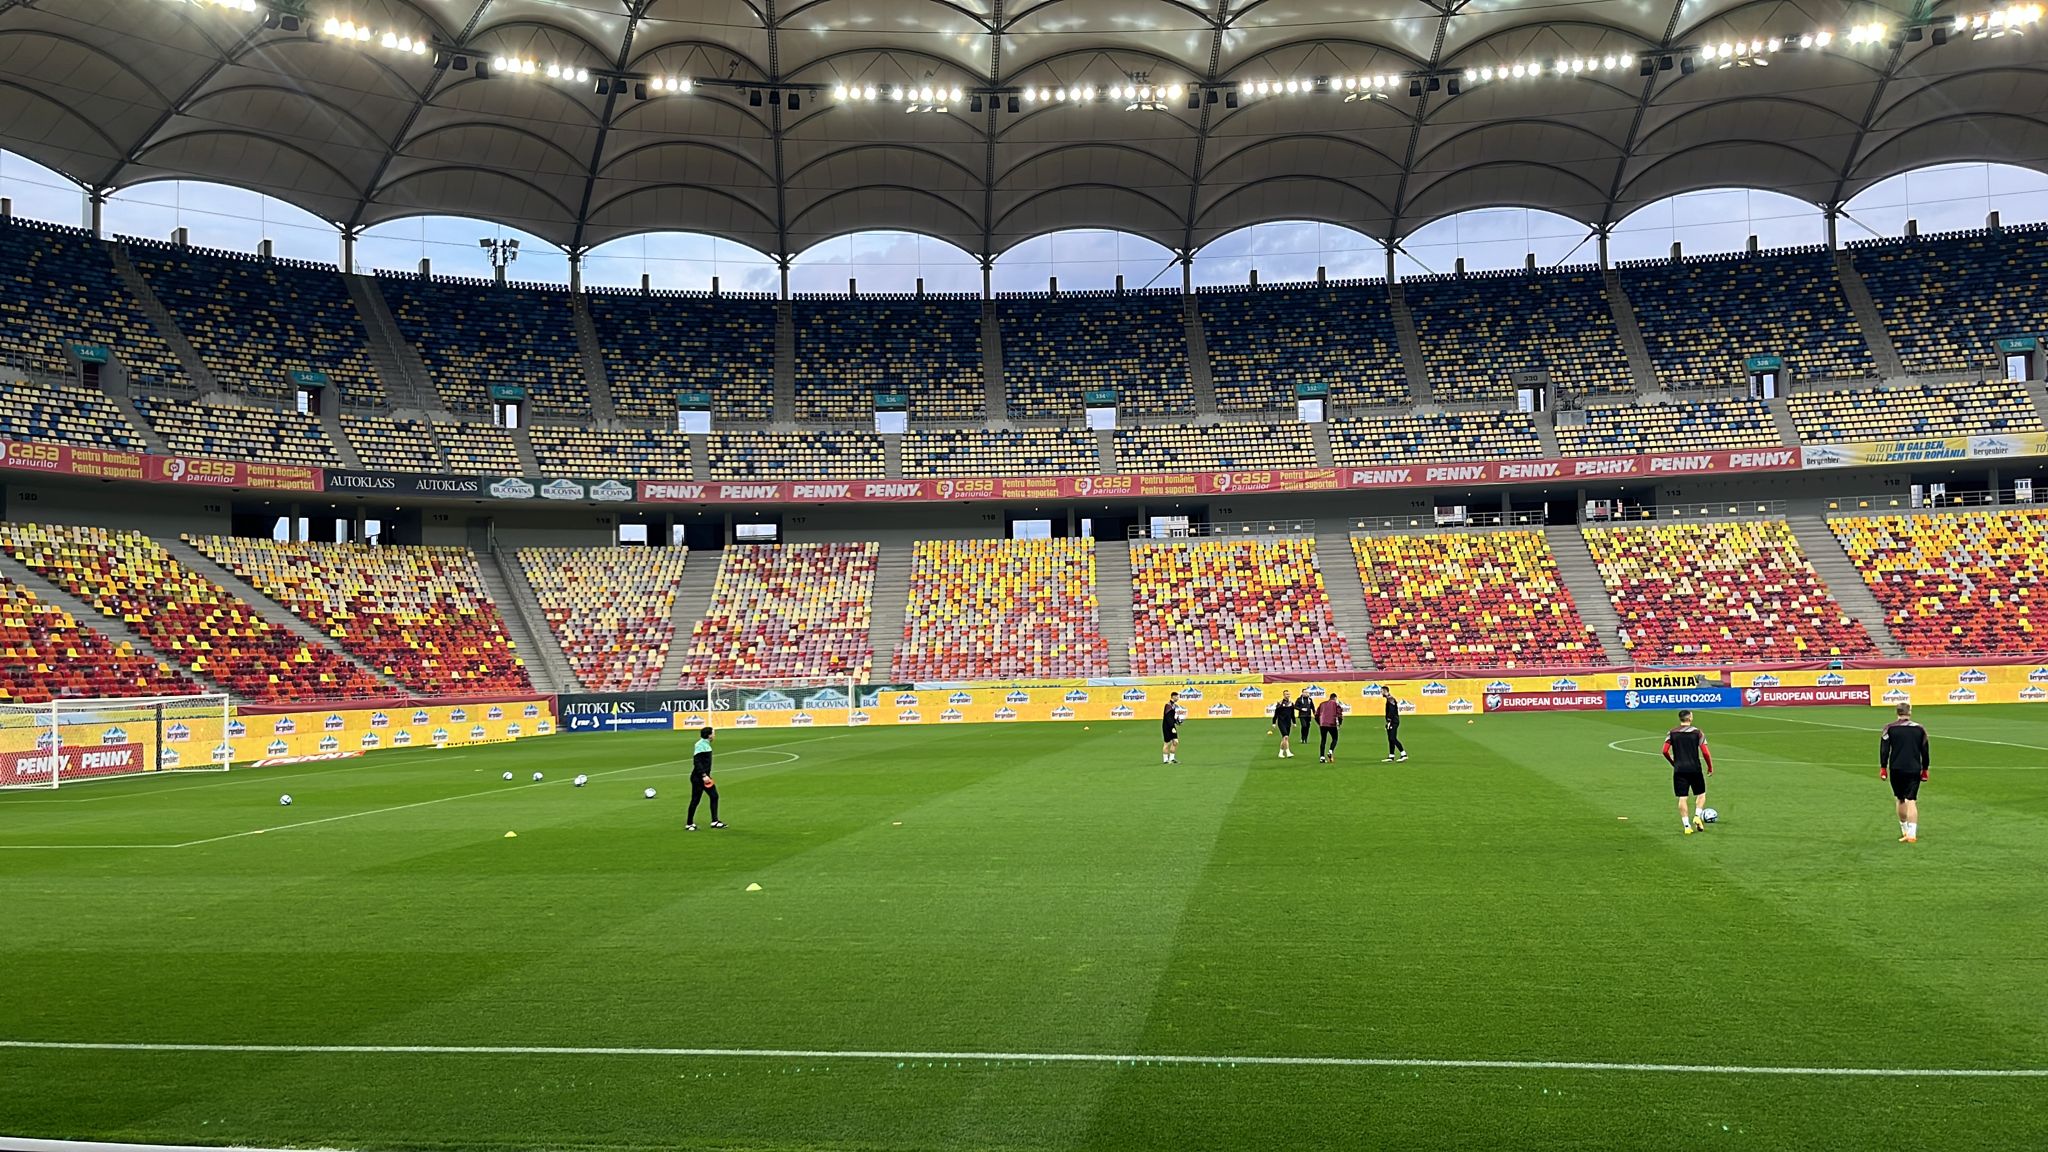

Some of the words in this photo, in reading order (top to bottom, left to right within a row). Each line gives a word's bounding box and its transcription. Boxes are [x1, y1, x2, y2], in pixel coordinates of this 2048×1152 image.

[80, 348, 94, 357] 344
[9, 442, 60, 461] casa
[71, 448, 101, 461] Pentru
[1886, 451, 1922, 462] PENTRU
[1924, 447, 1966, 460] ROMÂNIA
[8, 458, 59, 470] pariurilor
[72, 462, 101, 475] Pentru
[188, 460, 236, 476] casa
[247, 463, 276, 475] Pentru
[187, 473, 235, 484] pariurilor
[247, 476, 275, 488] Pentru
[330, 475, 396, 489] AUTOKLASS
[1093, 476, 1132, 488] casa
[1232, 472, 1272, 485] casa
[416, 479, 478, 492] AUTOKLASS
[493, 487, 532, 495] BUCOVINA
[956, 480, 993, 491] casa
[543, 488, 582, 496] BUCOVINA
[592, 489, 630, 497] BUCOVINA
[1634, 675, 1697, 688] ROMÂNIA
[1503, 697, 1550, 707] EUROPEAN
[1552, 696, 1604, 706] QUALIFIERS
[1763, 692, 1814, 702] EUROPEAN
[1816, 690, 1869, 701] QUALIFIERS
[747, 701, 793, 710] BUCOVINA
[805, 700, 850, 709] BUCOVINA
